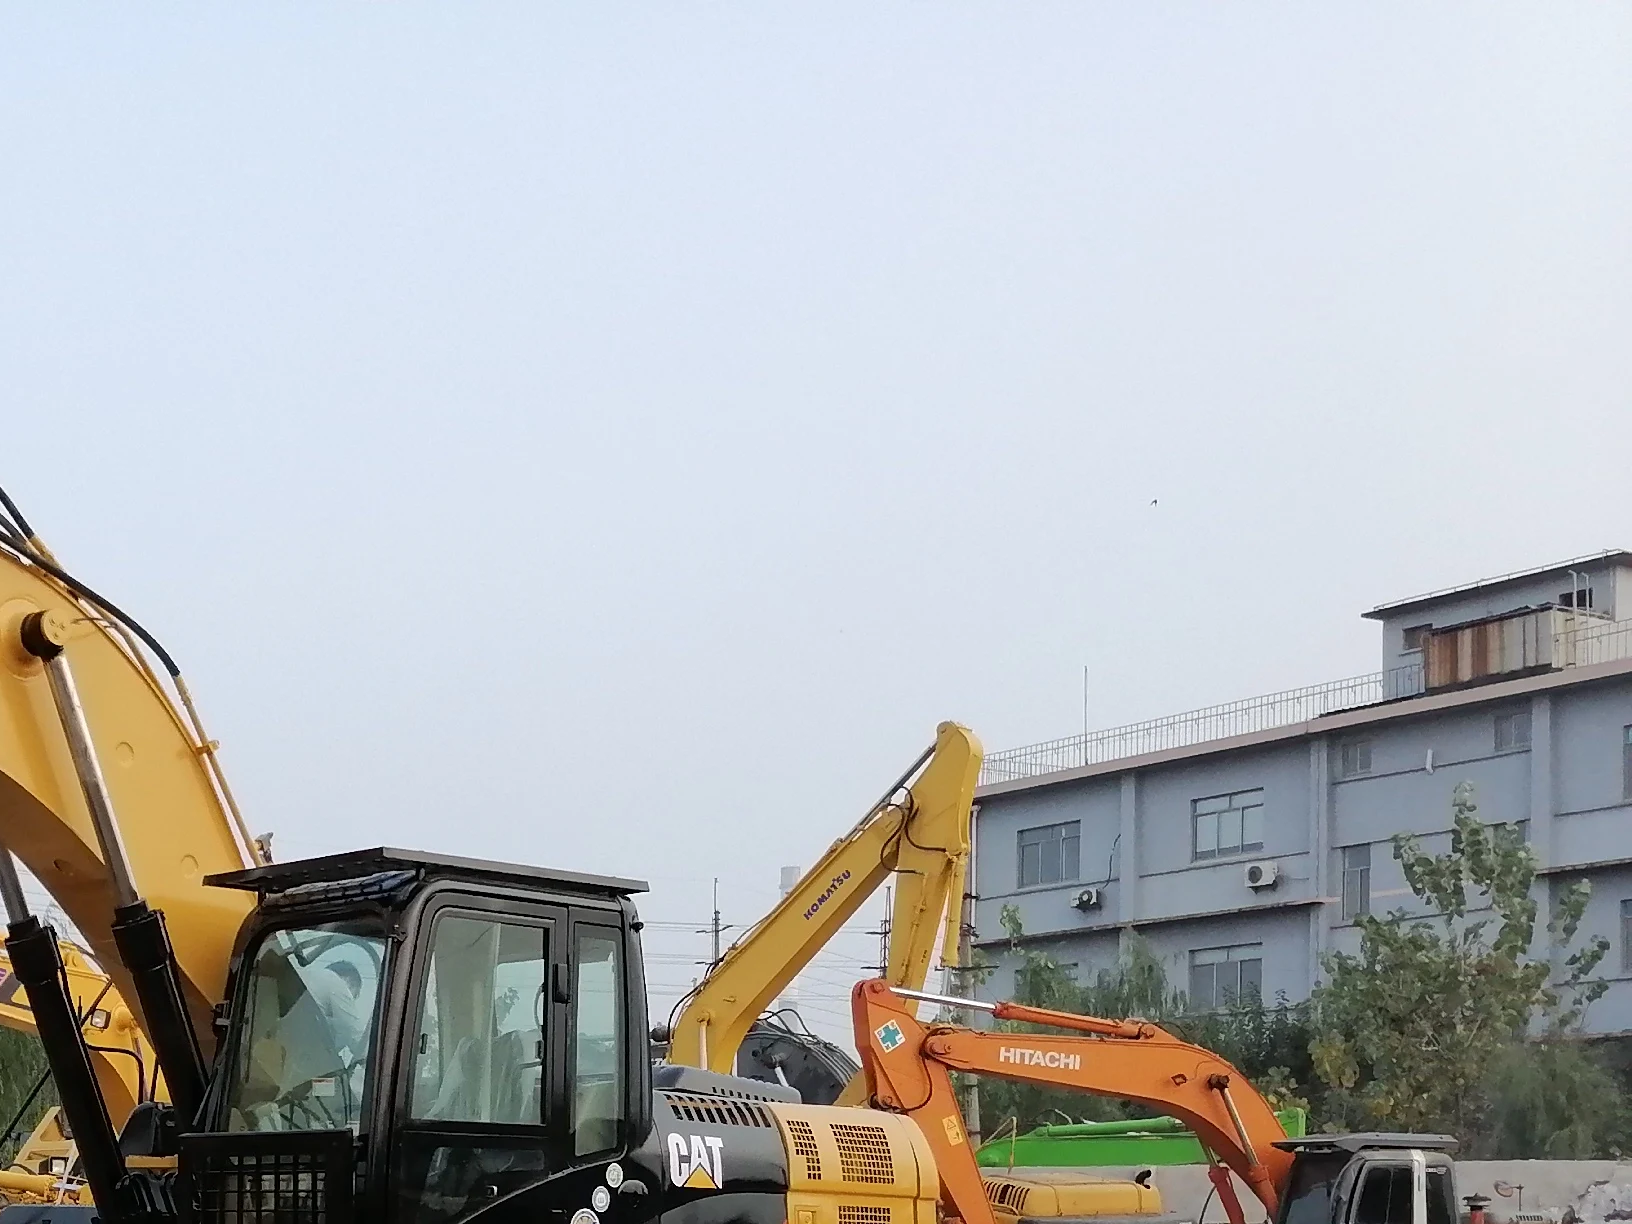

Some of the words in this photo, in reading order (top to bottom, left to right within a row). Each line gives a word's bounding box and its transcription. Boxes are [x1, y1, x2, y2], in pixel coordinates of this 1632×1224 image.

[803, 869, 851, 921] KOMATSU
[999, 1046, 1081, 1070] HITACHI
[667, 1132, 724, 1189] CAT
